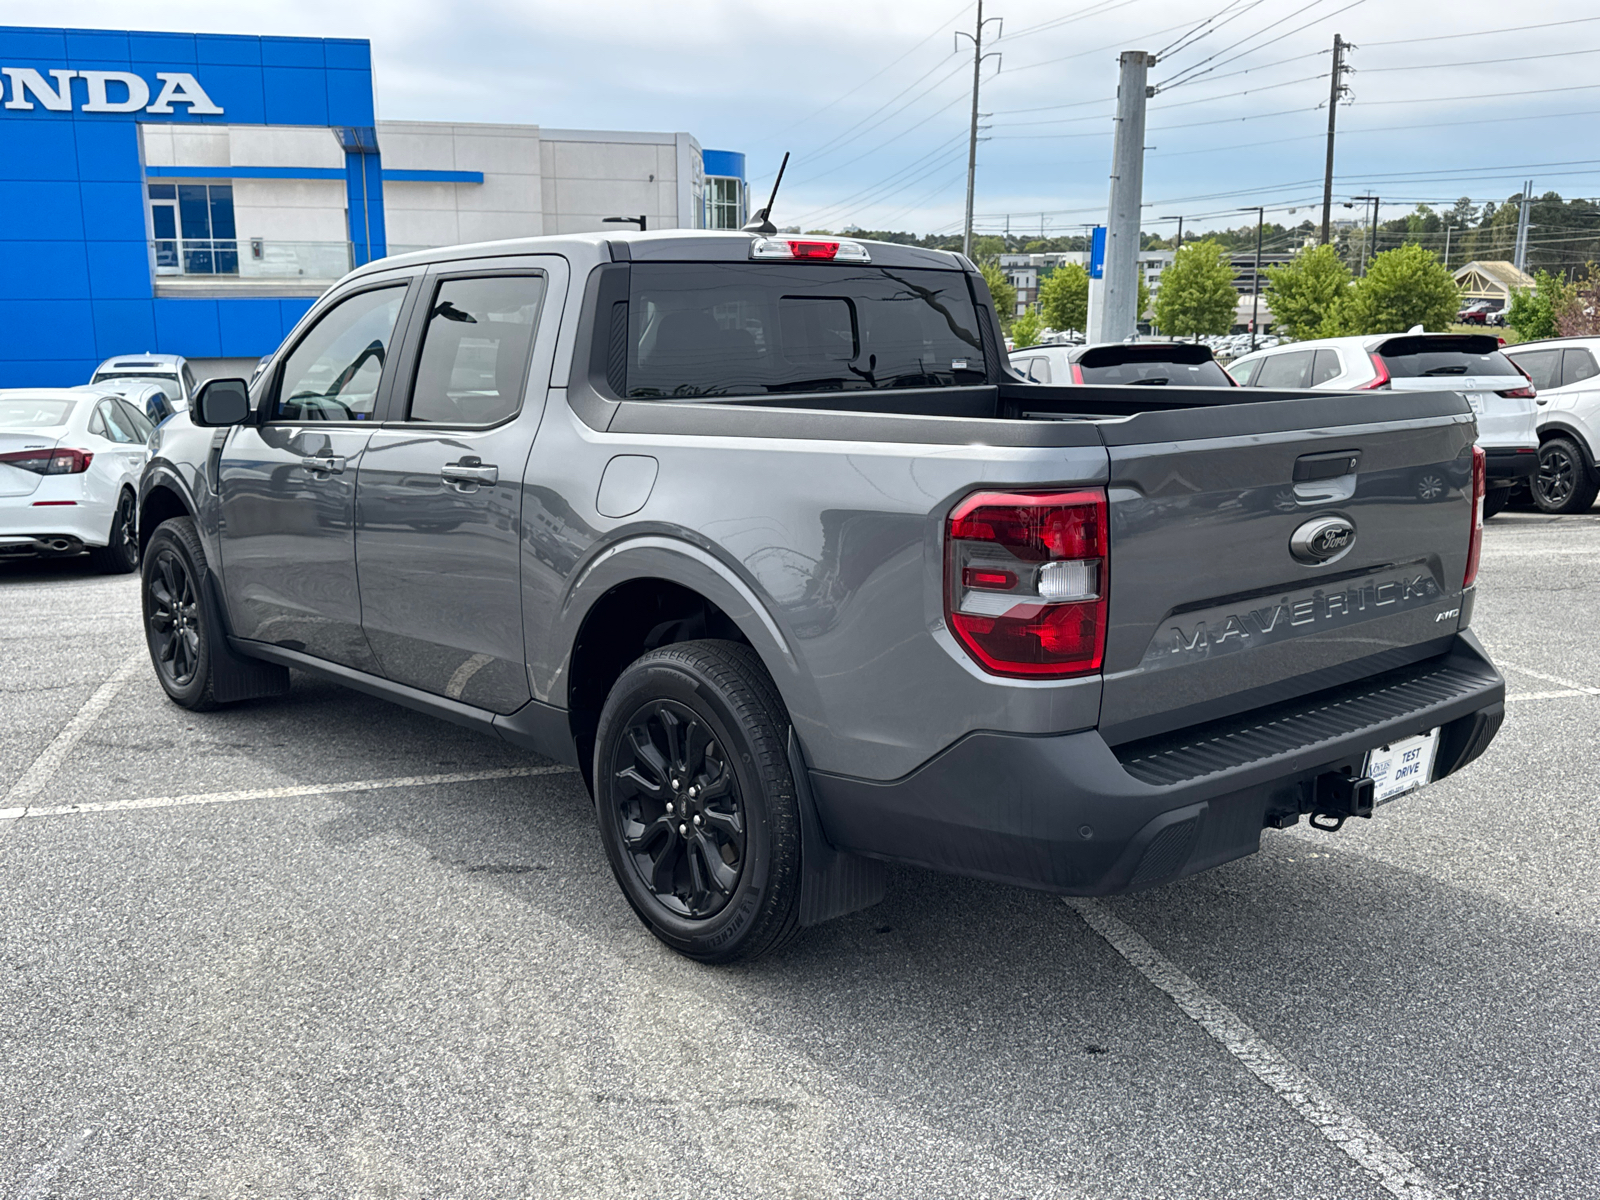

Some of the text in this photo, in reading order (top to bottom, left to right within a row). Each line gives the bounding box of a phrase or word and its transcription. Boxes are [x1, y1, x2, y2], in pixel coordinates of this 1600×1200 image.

[0, 66, 225, 115] NDA
[1321, 528, 1349, 550] Ford
[1170, 574, 1426, 654] MAVERICK
[1434, 608, 1460, 623] AWD
[1402, 747, 1422, 763] TEST
[1395, 762, 1420, 780] DRIVE
